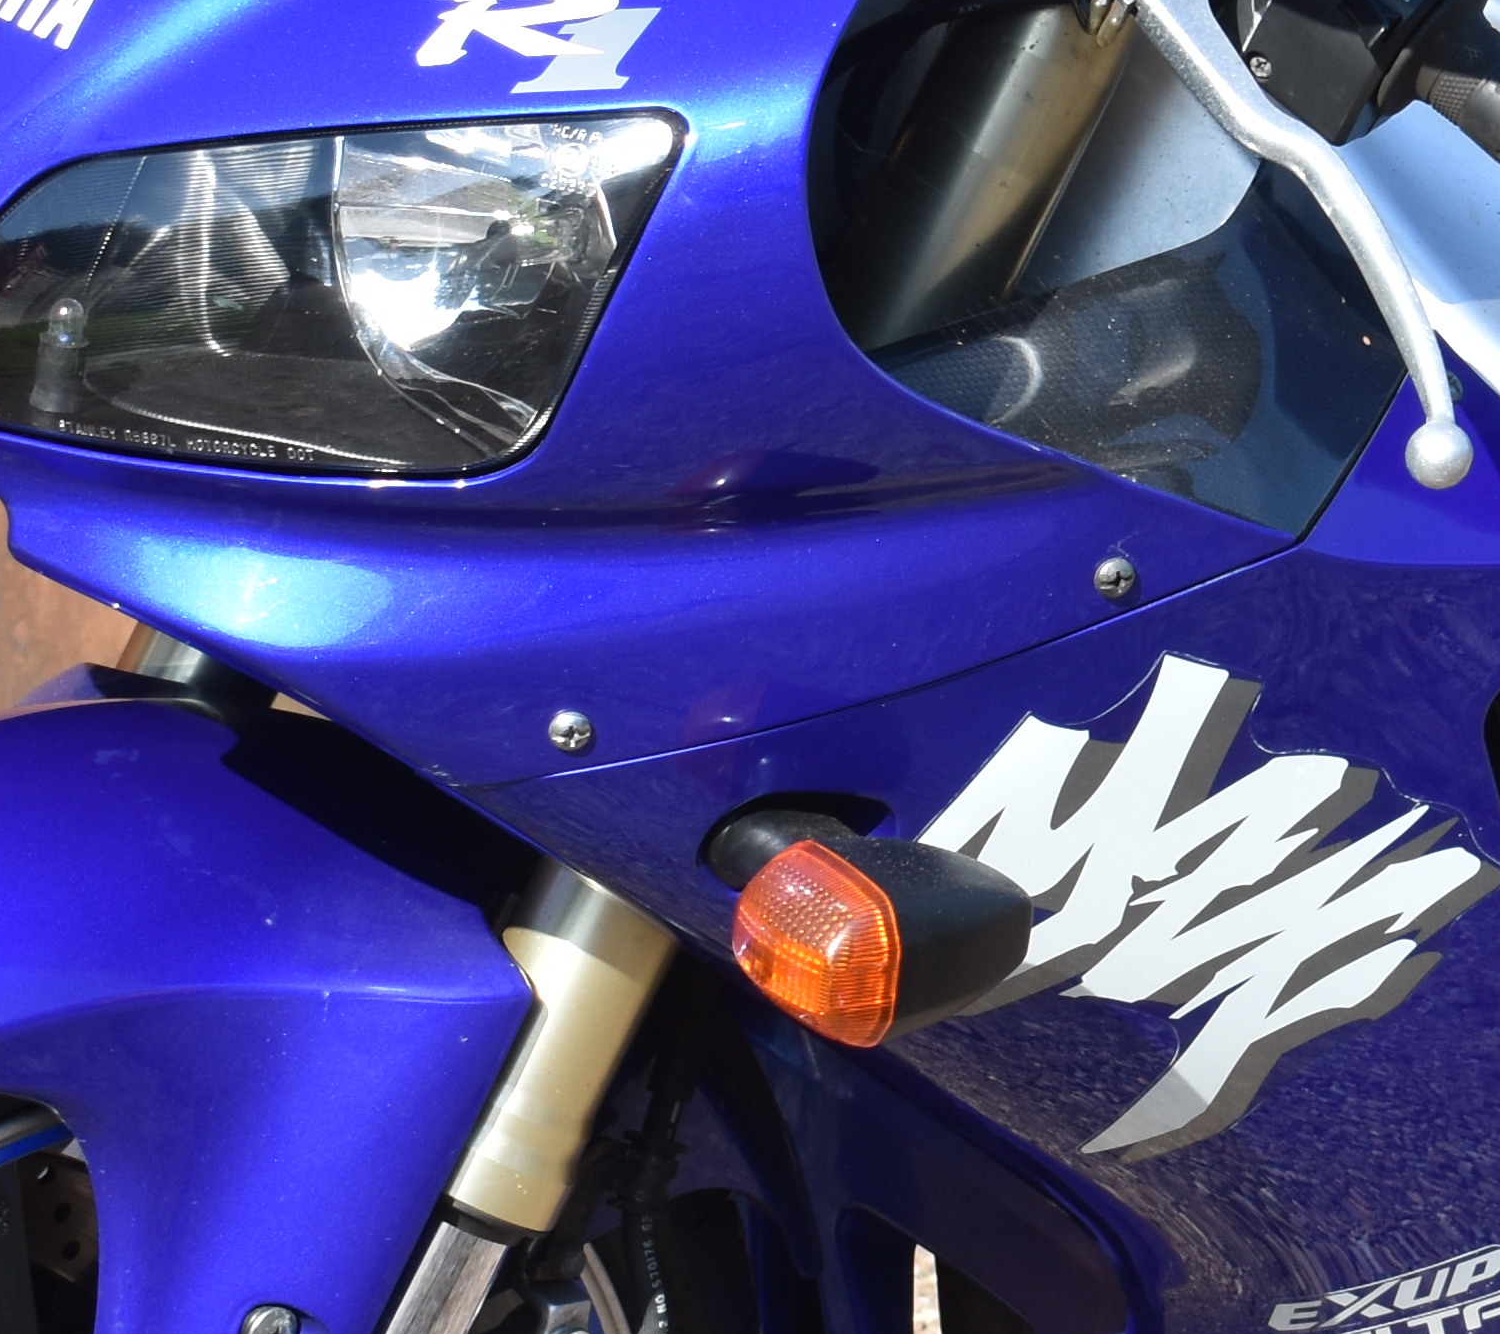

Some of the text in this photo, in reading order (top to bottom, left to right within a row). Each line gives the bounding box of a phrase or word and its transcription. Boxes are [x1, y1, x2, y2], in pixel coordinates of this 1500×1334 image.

[58, 418, 117, 441] STANLEY
[185, 438, 277, 459] MOTORCYCLE
[286, 446, 315, 463] DOT
